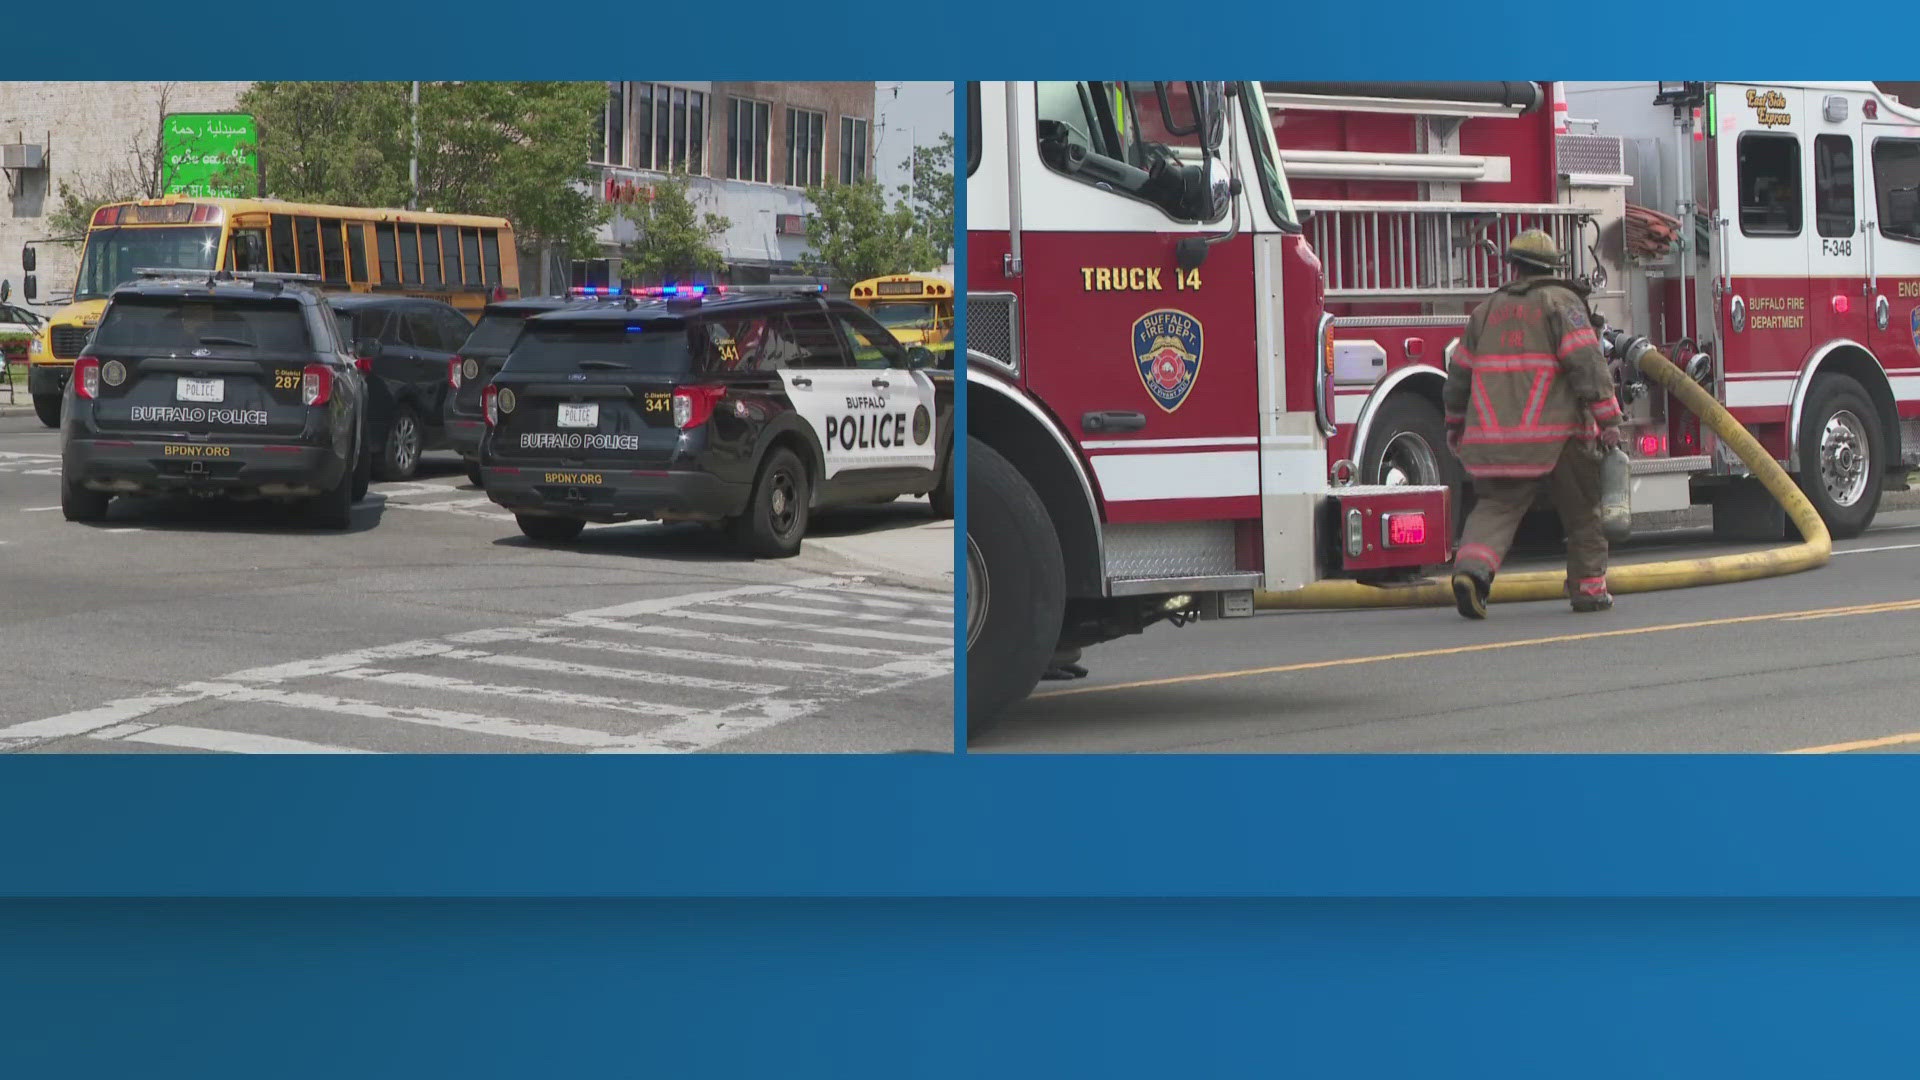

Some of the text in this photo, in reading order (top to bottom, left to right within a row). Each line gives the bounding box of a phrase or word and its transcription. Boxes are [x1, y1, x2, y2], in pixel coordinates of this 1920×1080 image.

[1746, 89, 1787, 109] East Side
[1757, 107, 1791, 128] Express
[172, 120, 246, 138] صيدلية رحمة
[1822, 239, 1851, 256] F-348
[1081, 267, 1202, 291] TRUCK 14
[1749, 298, 1804, 310] BUFFALO FIRE
[1143, 314, 1191, 329] BUFFALO
[1751, 316, 1804, 329] DEPARTMENT
[1140, 324, 1196, 346] FIRE DEPT.
[719, 345, 739, 361] 341
[186, 384, 215, 396] POLICE
[275, 376, 300, 389] 287
[646, 399, 671, 412] 341
[846, 396, 885, 409] BUFFALO
[131, 406, 268, 425] BUFFALO POLICE
[565, 409, 590, 422] POLICE
[826, 413, 906, 451] POLICE
[520, 433, 638, 450] BUFFALO POLICE
[164, 445, 230, 457] BPDNY.ORG
[545, 472, 602, 484] BPDNY.ORG
